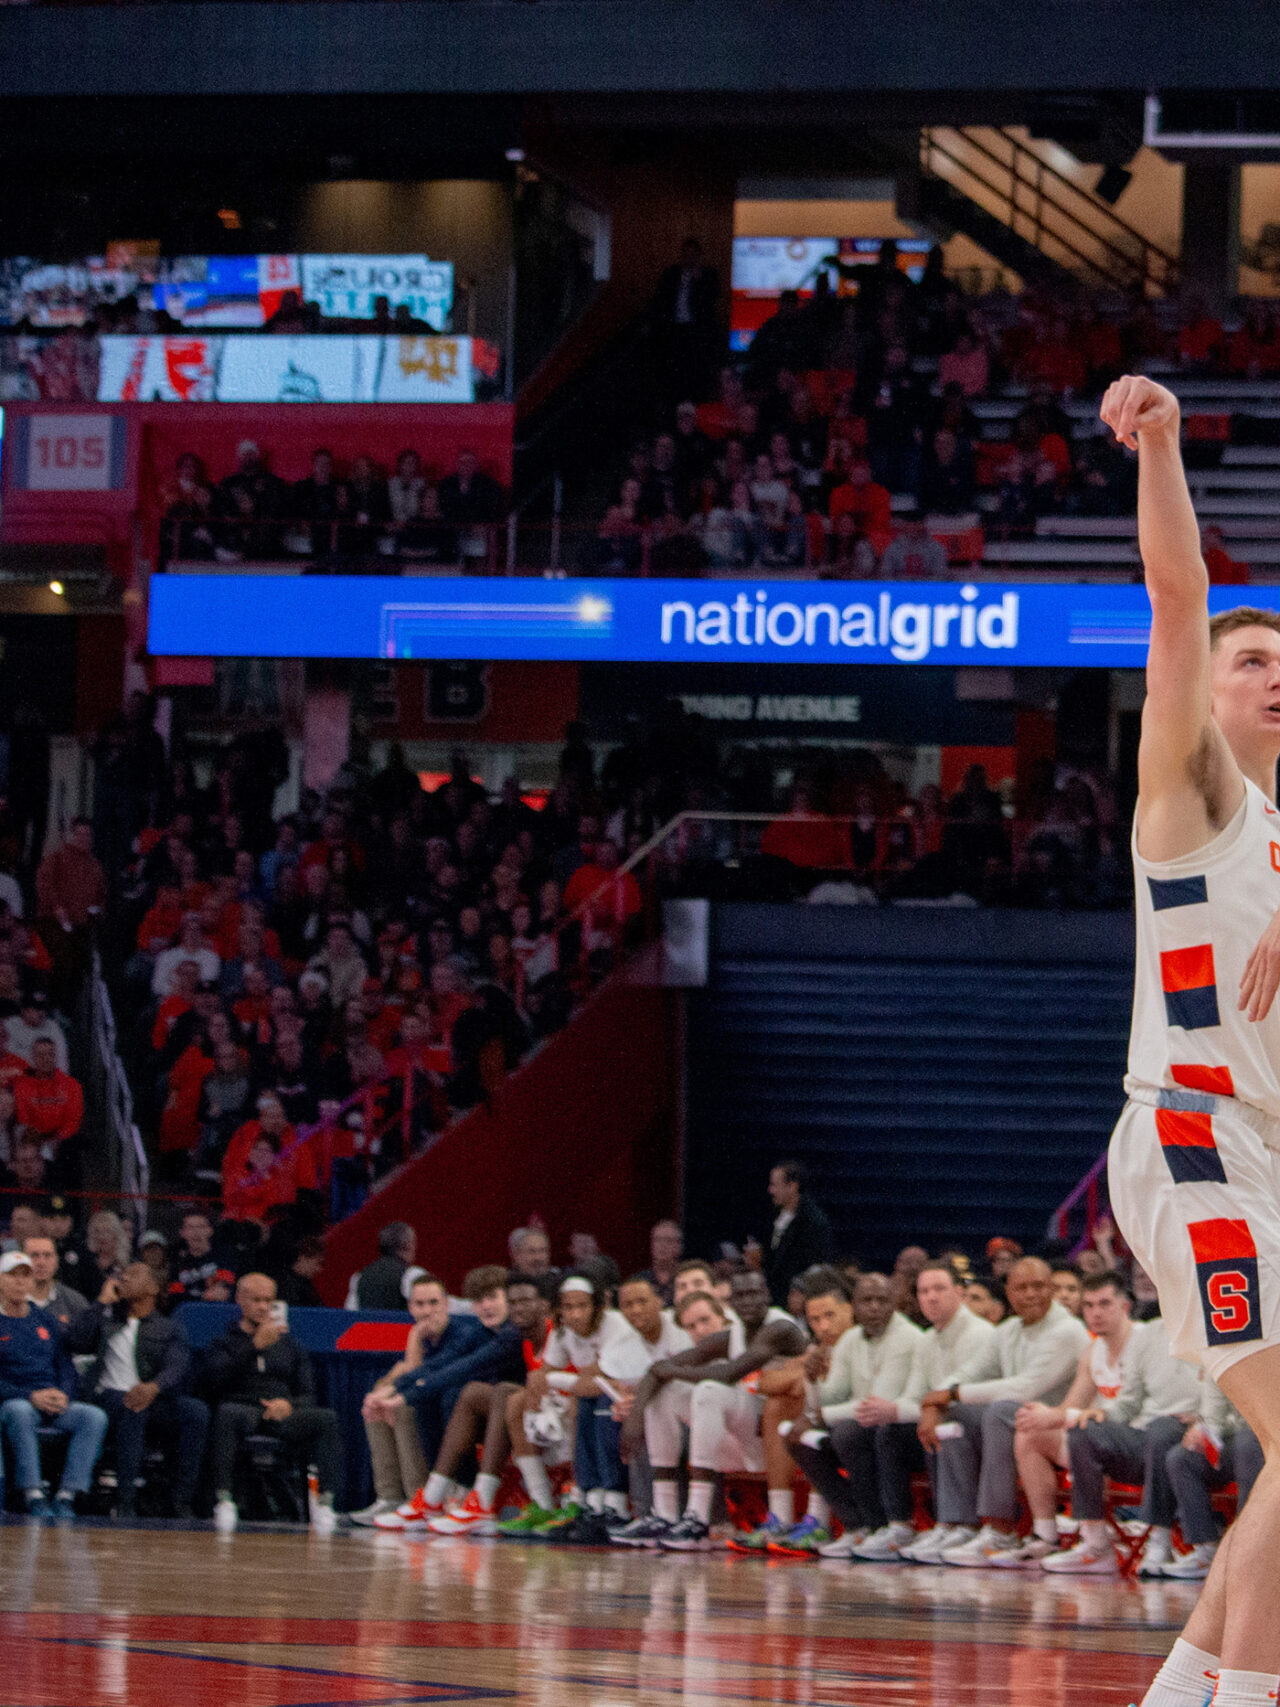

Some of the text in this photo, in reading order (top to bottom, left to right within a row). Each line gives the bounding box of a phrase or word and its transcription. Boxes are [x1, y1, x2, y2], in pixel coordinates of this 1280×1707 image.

[36, 436, 105, 468] 105
[756, 694, 862, 722] AVENUE
[1207, 1270, 1251, 1333] S
